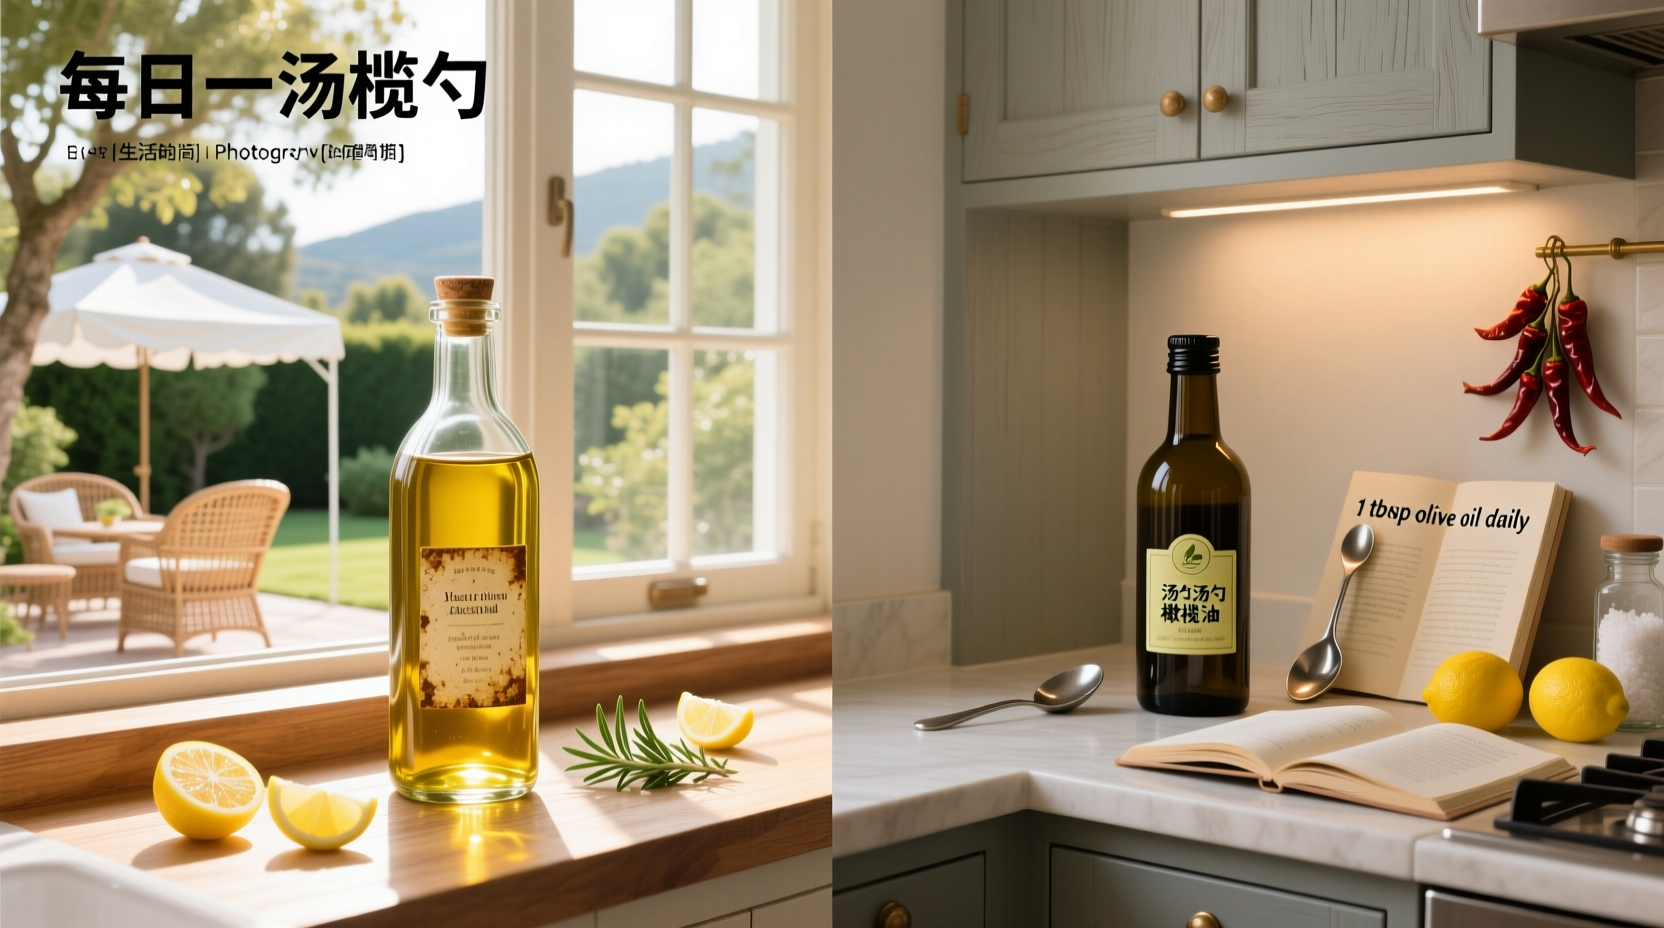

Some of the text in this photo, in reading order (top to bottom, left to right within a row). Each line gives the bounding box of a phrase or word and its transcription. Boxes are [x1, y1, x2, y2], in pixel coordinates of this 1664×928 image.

[1357, 499, 1365, 516] 1
[1415, 504, 1456, 526] olive
[1461, 507, 1482, 526] oil
[1486, 509, 1529, 534] daily
